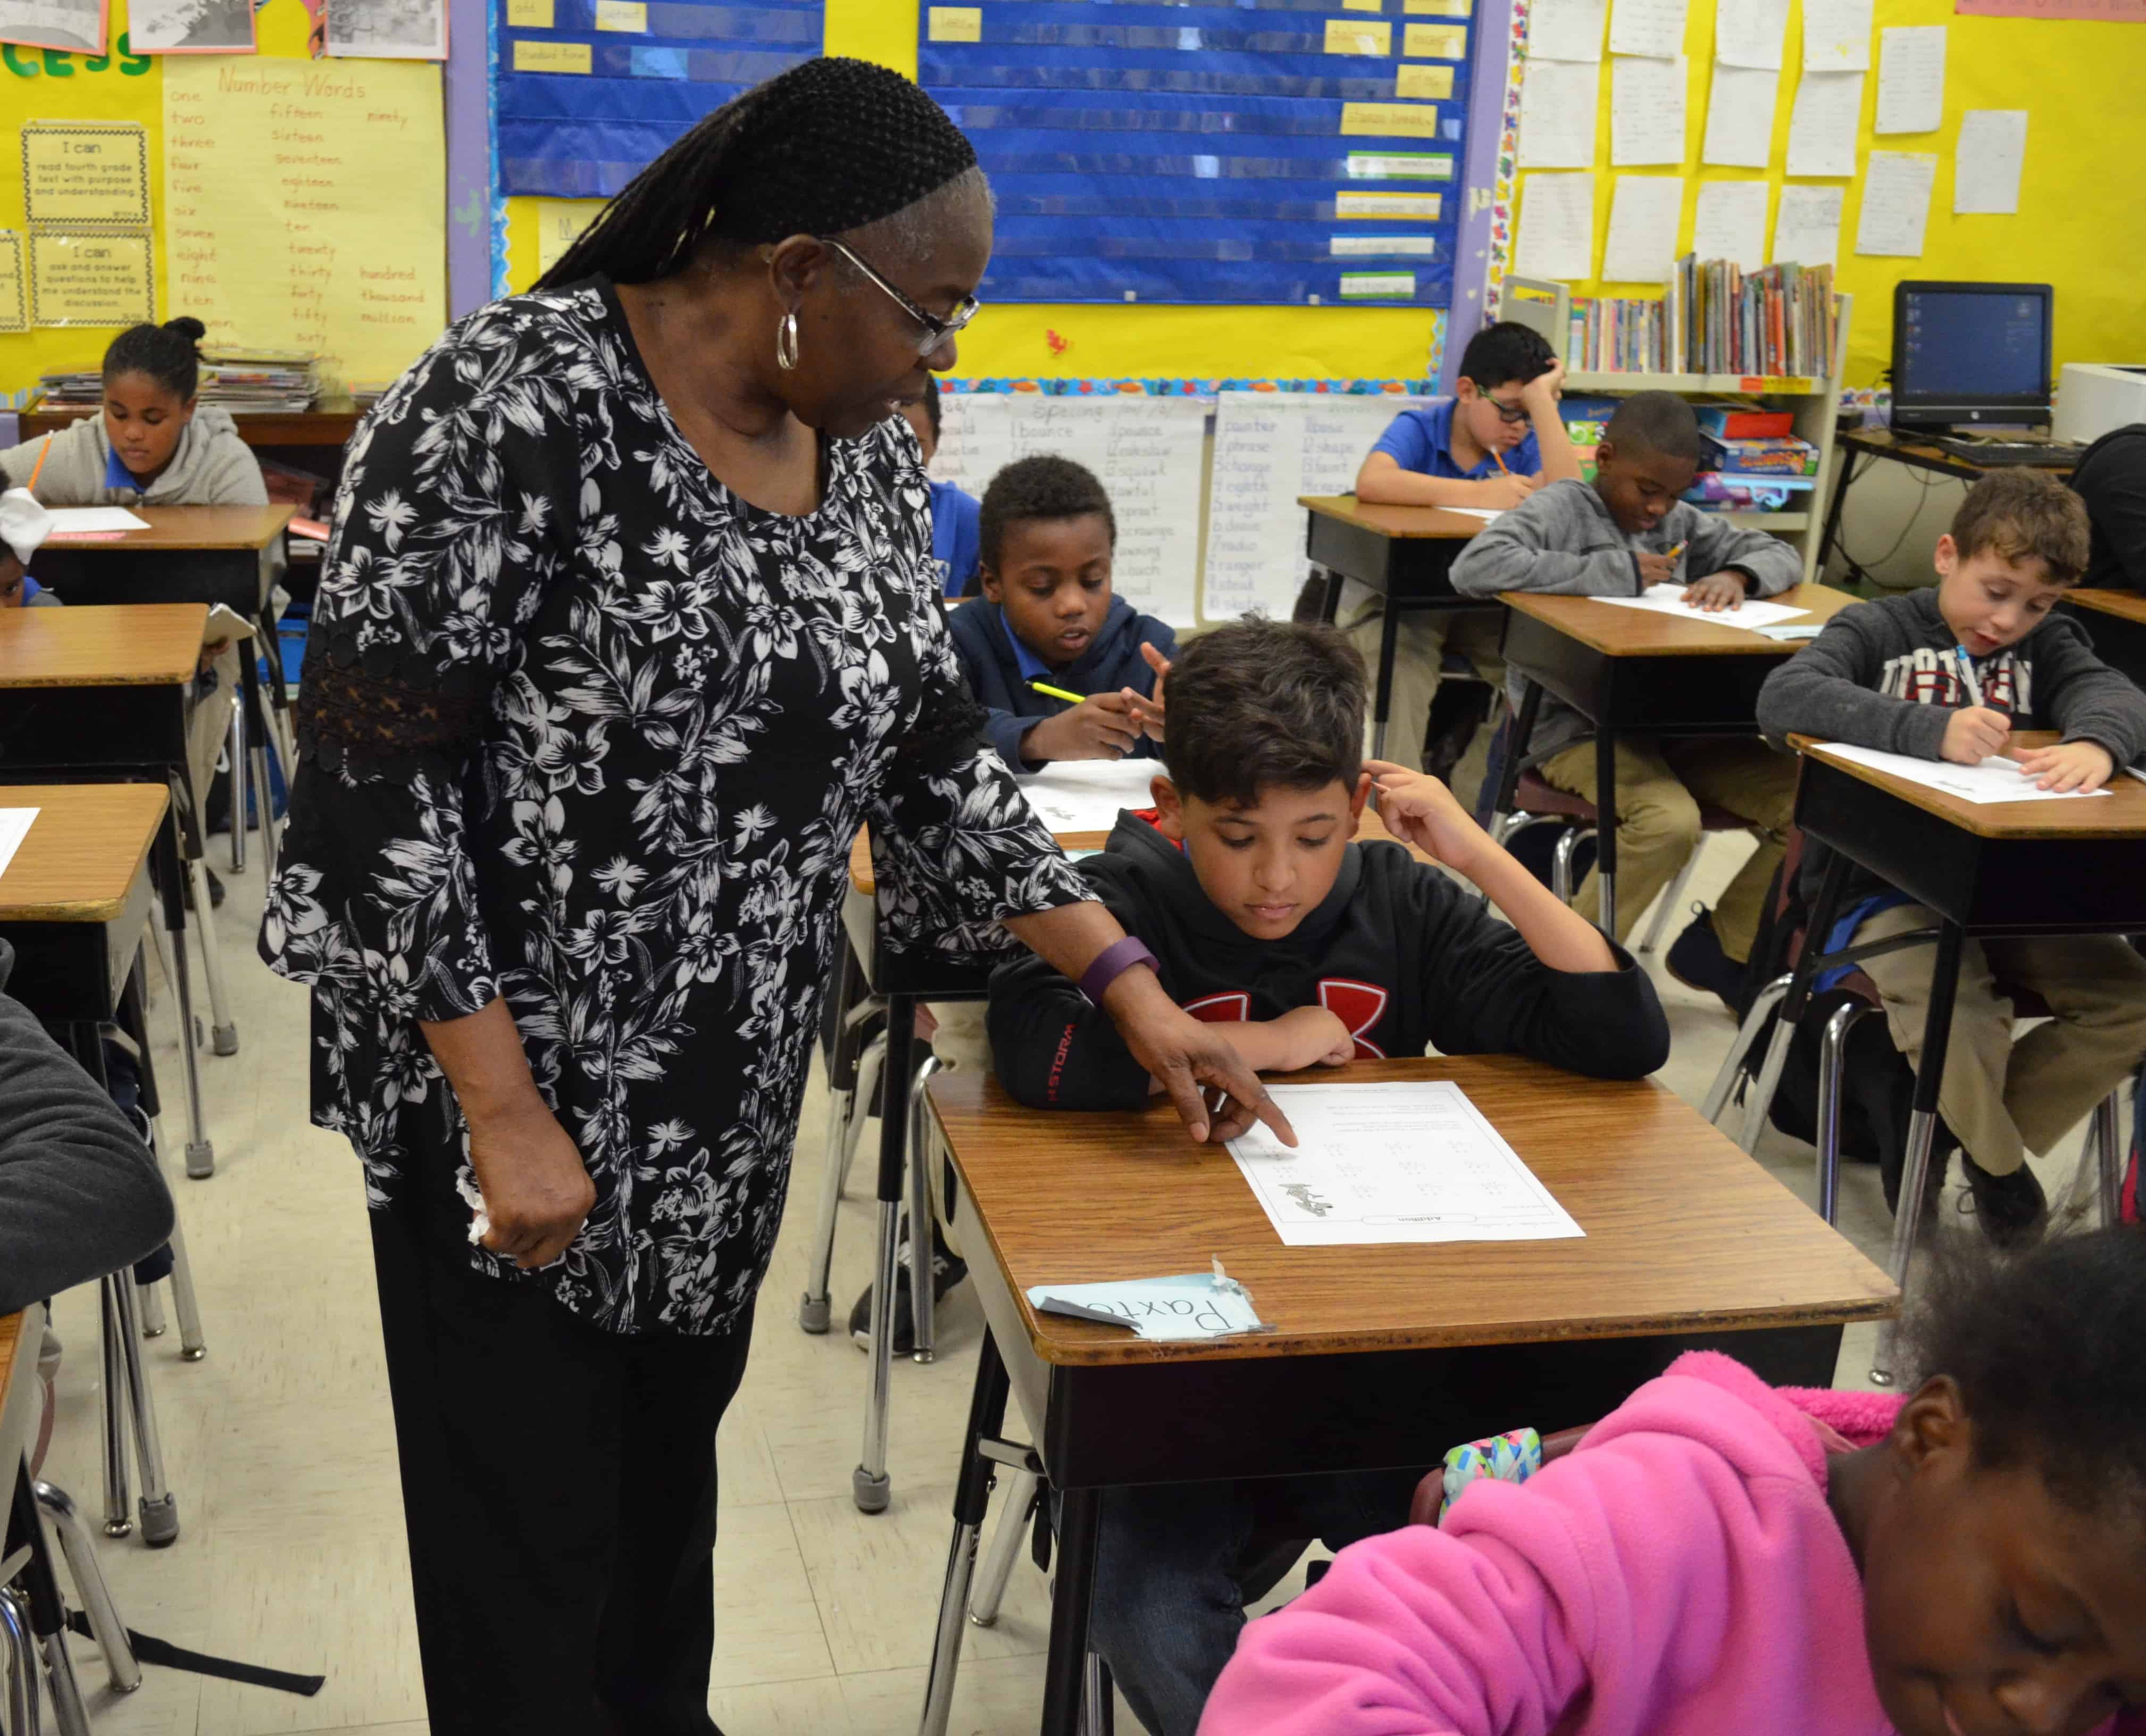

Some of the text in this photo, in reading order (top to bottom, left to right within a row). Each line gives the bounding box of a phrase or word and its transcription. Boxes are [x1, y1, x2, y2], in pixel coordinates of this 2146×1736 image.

[219, 66, 366, 98] Number Words
[170, 91, 202, 102] one
[171, 111, 205, 125] two
[270, 103, 323, 119] fifteen
[171, 135, 215, 148] three
[271, 128, 324, 143] sixteen
[73, 143, 102, 154] can
[275, 152, 343, 166] seventeen
[65, 162, 97, 171] fourth
[101, 163, 132, 173] grade
[38, 174, 132, 186] text with purpose
[172, 179, 203, 193] five
[34, 187, 55, 195] and
[174, 207, 196, 216] six
[84, 248, 112, 258] can
[288, 242, 336, 262] twenty
[359, 265, 416, 281] hundred
[183, 293, 214, 306] ten
[361, 289, 424, 303] thousand
[292, 307, 328, 329] fifty
[1020, 421, 1074, 438] bounce
[1048, 1022, 1078, 1088] STORM
